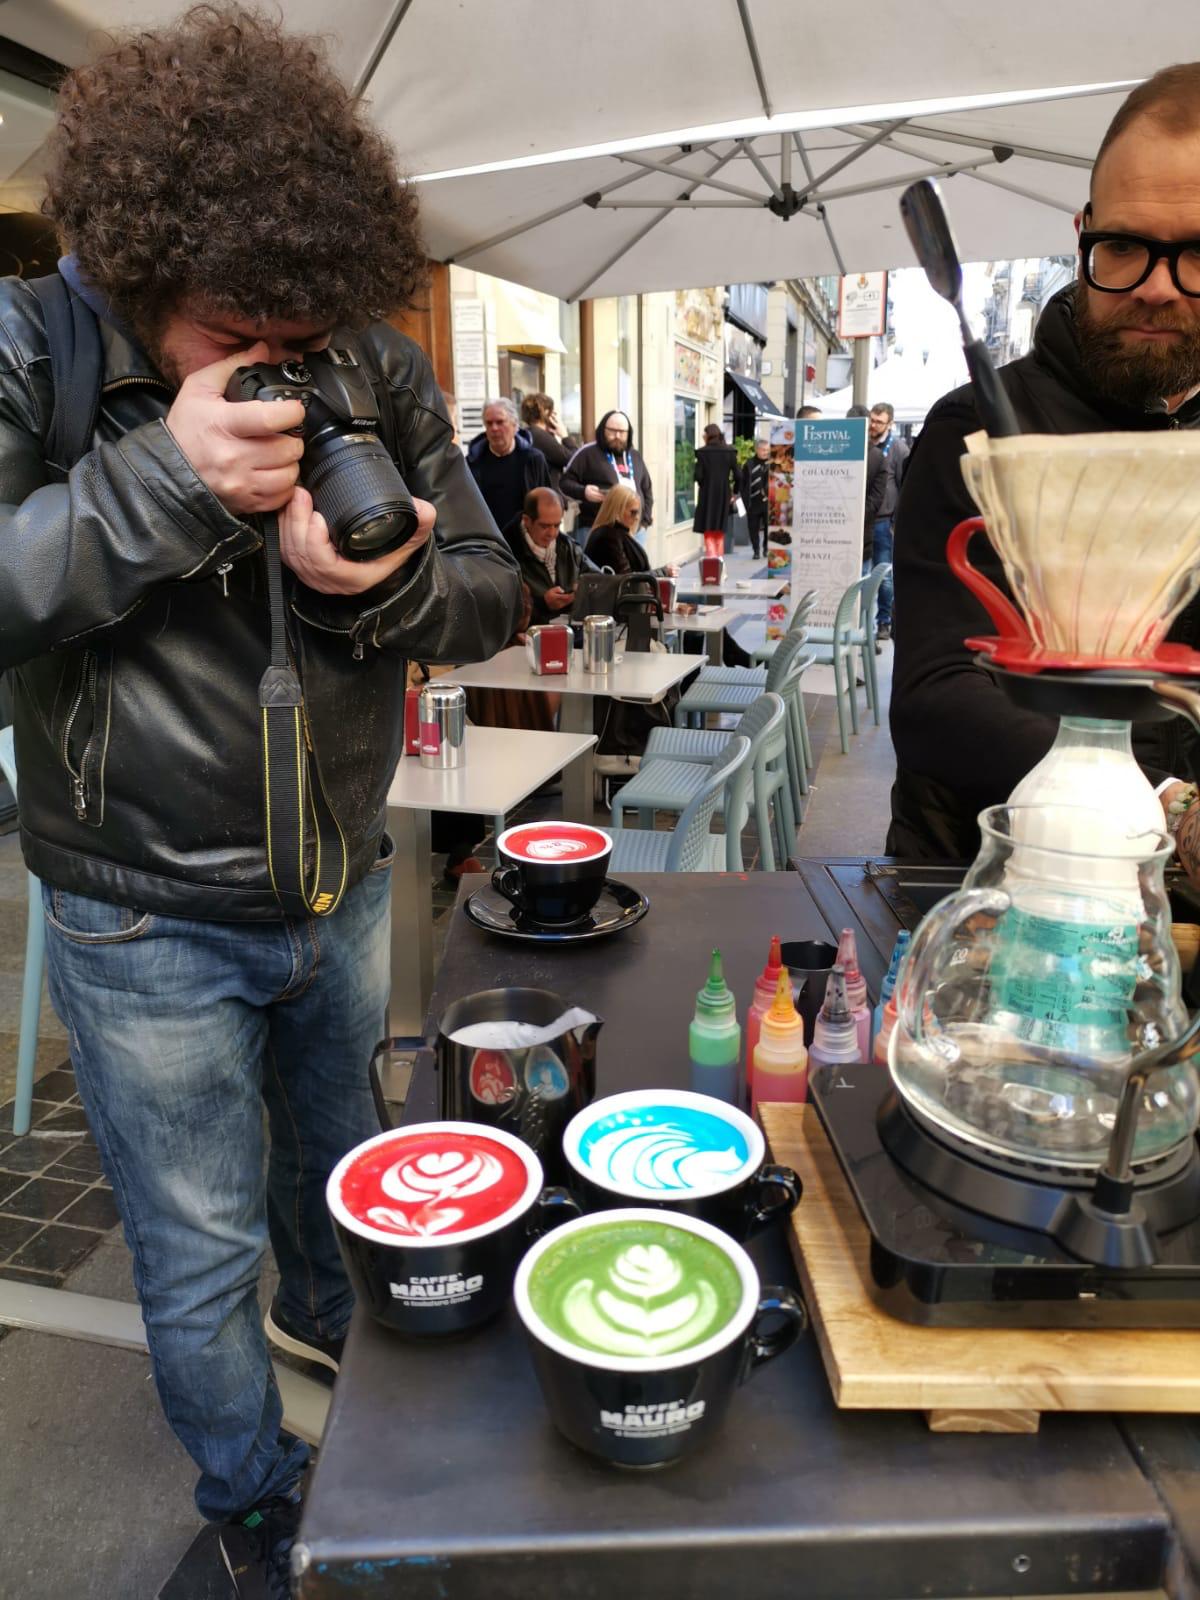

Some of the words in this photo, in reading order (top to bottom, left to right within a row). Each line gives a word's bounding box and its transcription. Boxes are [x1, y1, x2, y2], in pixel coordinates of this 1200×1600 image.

[803, 424, 851, 441] FESTIVAL
[389, 1274, 484, 1298] MAURO
[600, 1399, 706, 1428] MAURO
